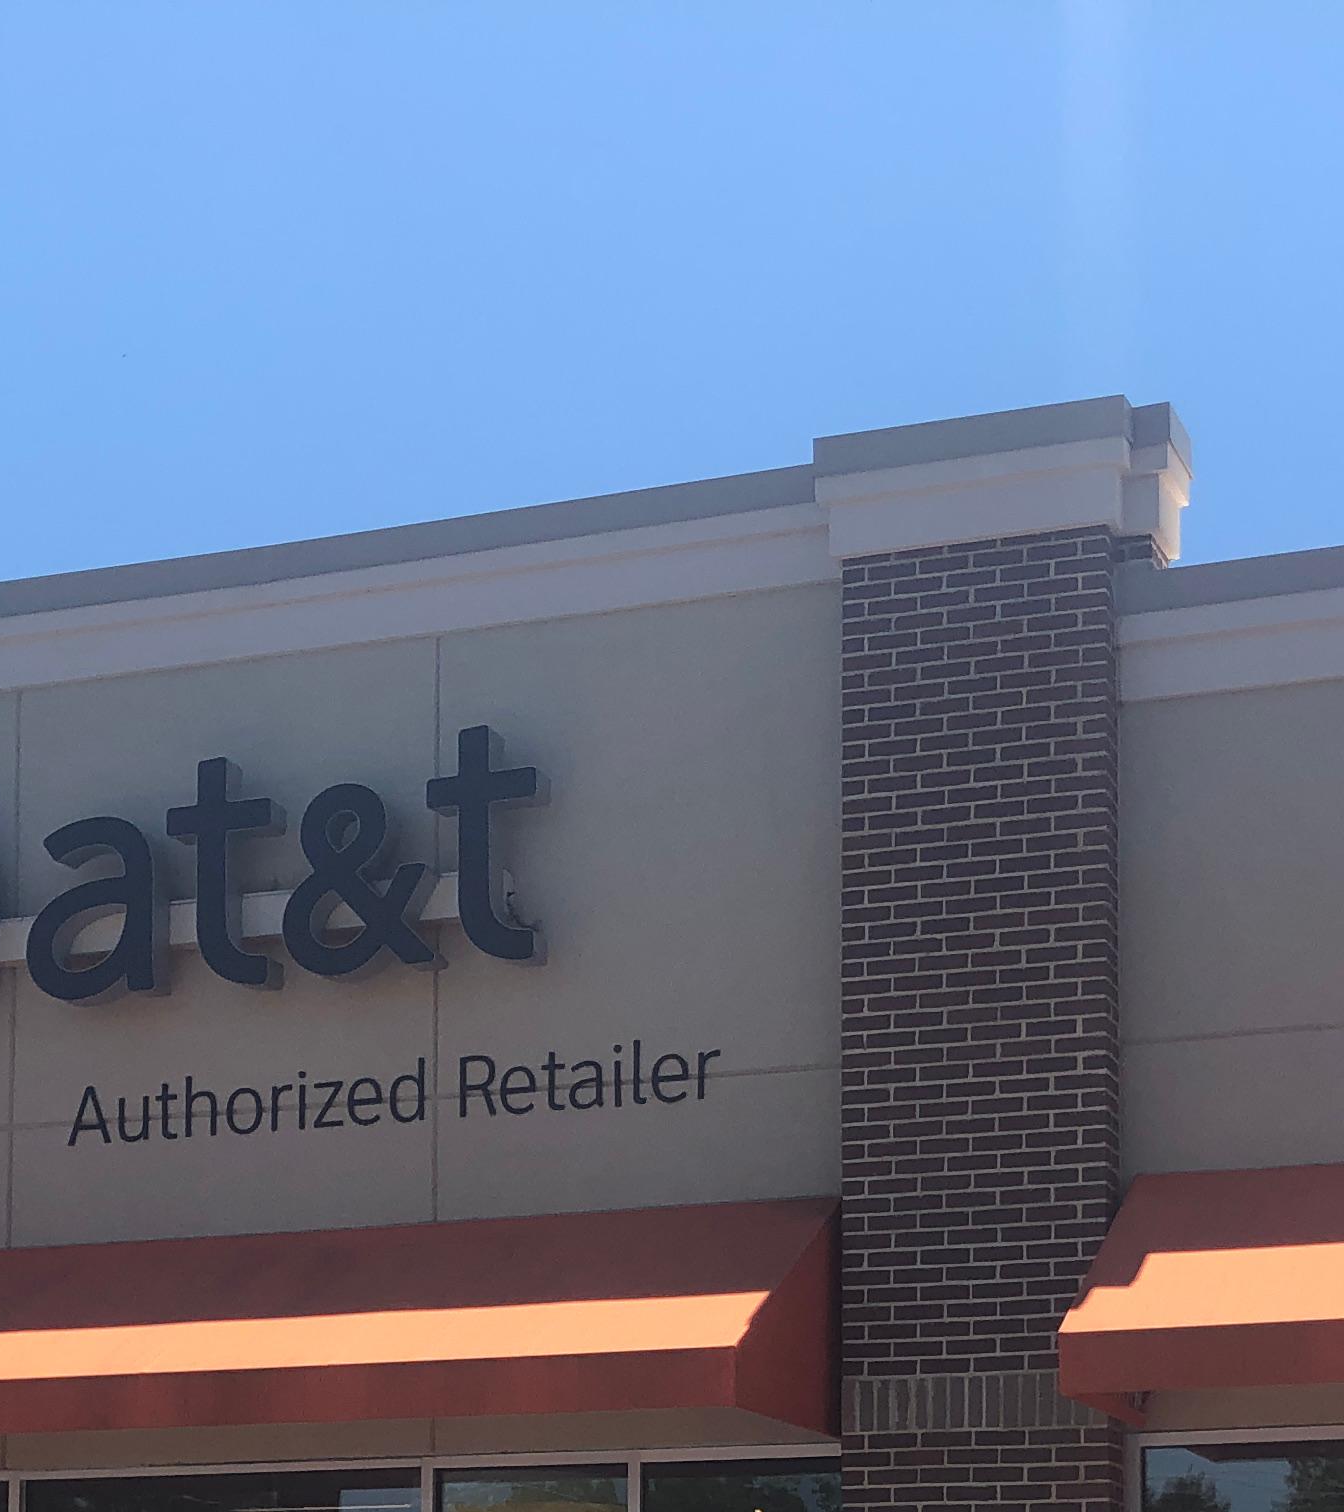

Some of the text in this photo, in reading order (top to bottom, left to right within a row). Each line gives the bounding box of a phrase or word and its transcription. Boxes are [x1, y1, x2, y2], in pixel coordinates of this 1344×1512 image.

[25, 725, 546, 1002] at&t
[67, 1040, 721, 1147] Authorized Retailer
